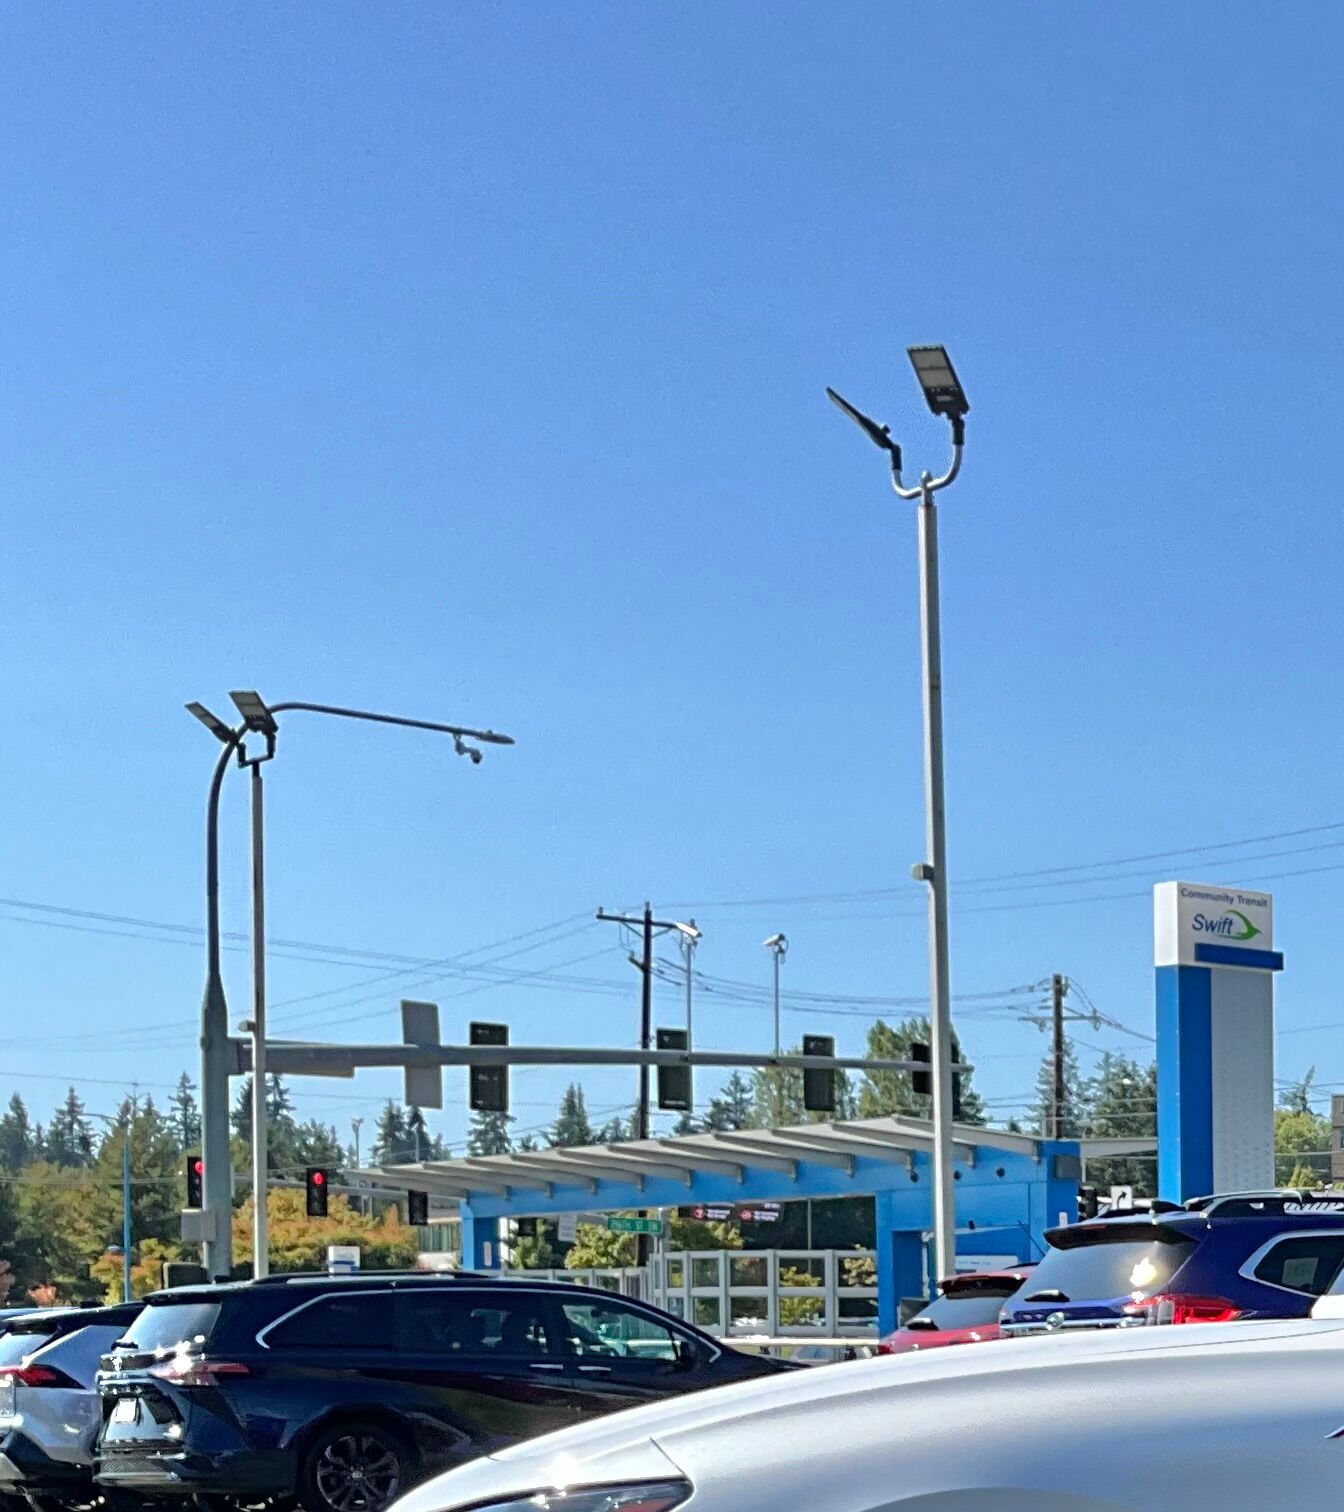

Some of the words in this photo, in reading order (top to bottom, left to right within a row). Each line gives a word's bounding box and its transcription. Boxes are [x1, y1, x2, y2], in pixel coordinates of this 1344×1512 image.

[1181, 887, 1234, 904] Community
[1237, 895, 1267, 907] Transit
[1192, 913, 1234, 934] Swift
